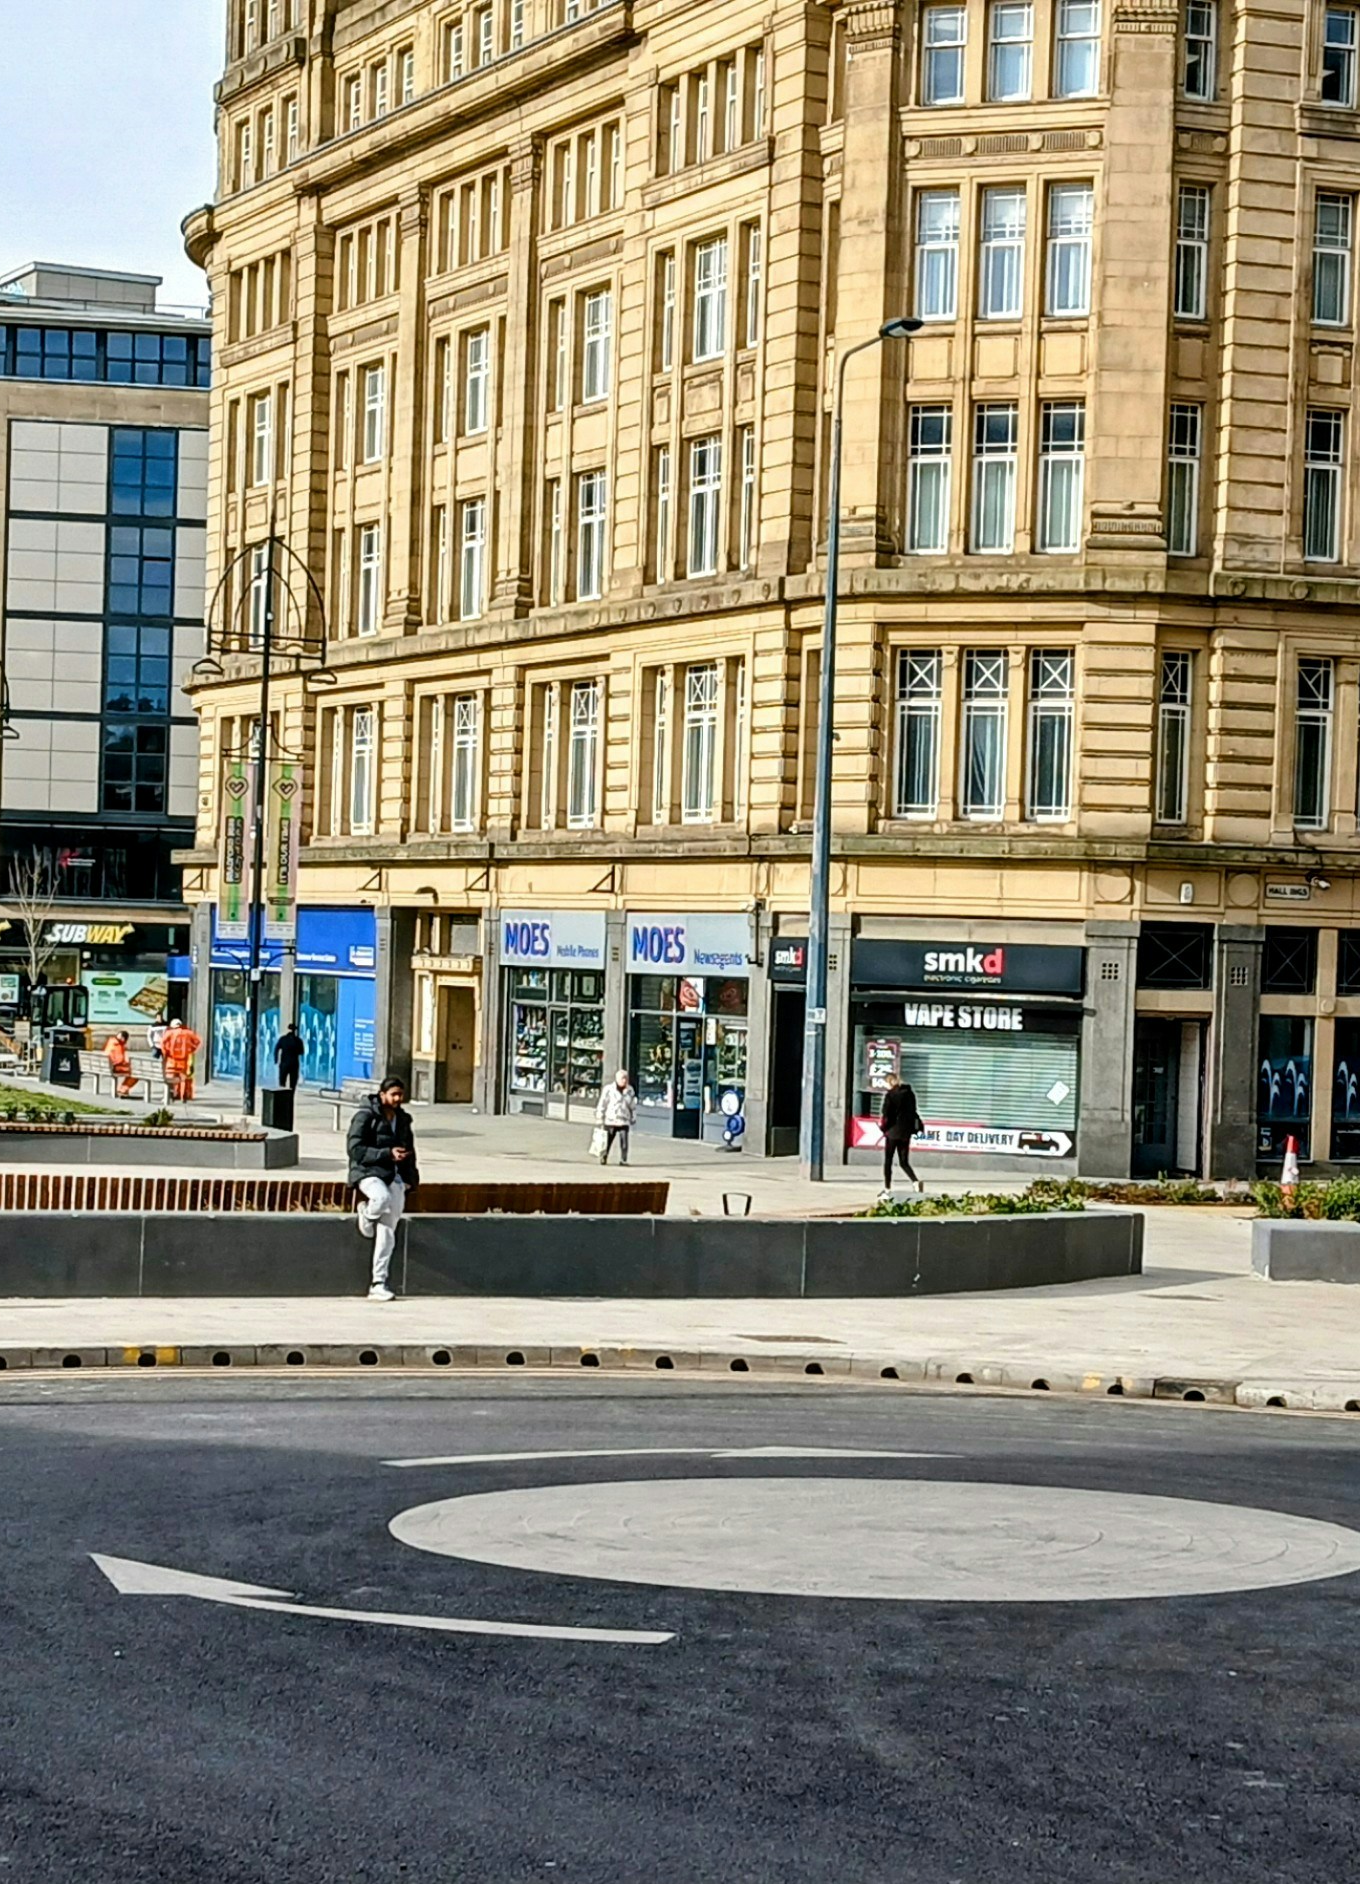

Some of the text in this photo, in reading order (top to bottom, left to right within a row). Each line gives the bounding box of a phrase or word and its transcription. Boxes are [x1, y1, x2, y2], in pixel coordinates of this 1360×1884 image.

[44, 922, 135, 944] SUBWAY
[505, 922, 549, 956] MOES
[632, 926, 685, 963] MOES
[775, 946, 803, 965] smkd
[924, 947, 1003, 974] smkd
[904, 1003, 1023, 1030] VAPE STORE
[967, 1132, 1014, 1146] DELIVERY
